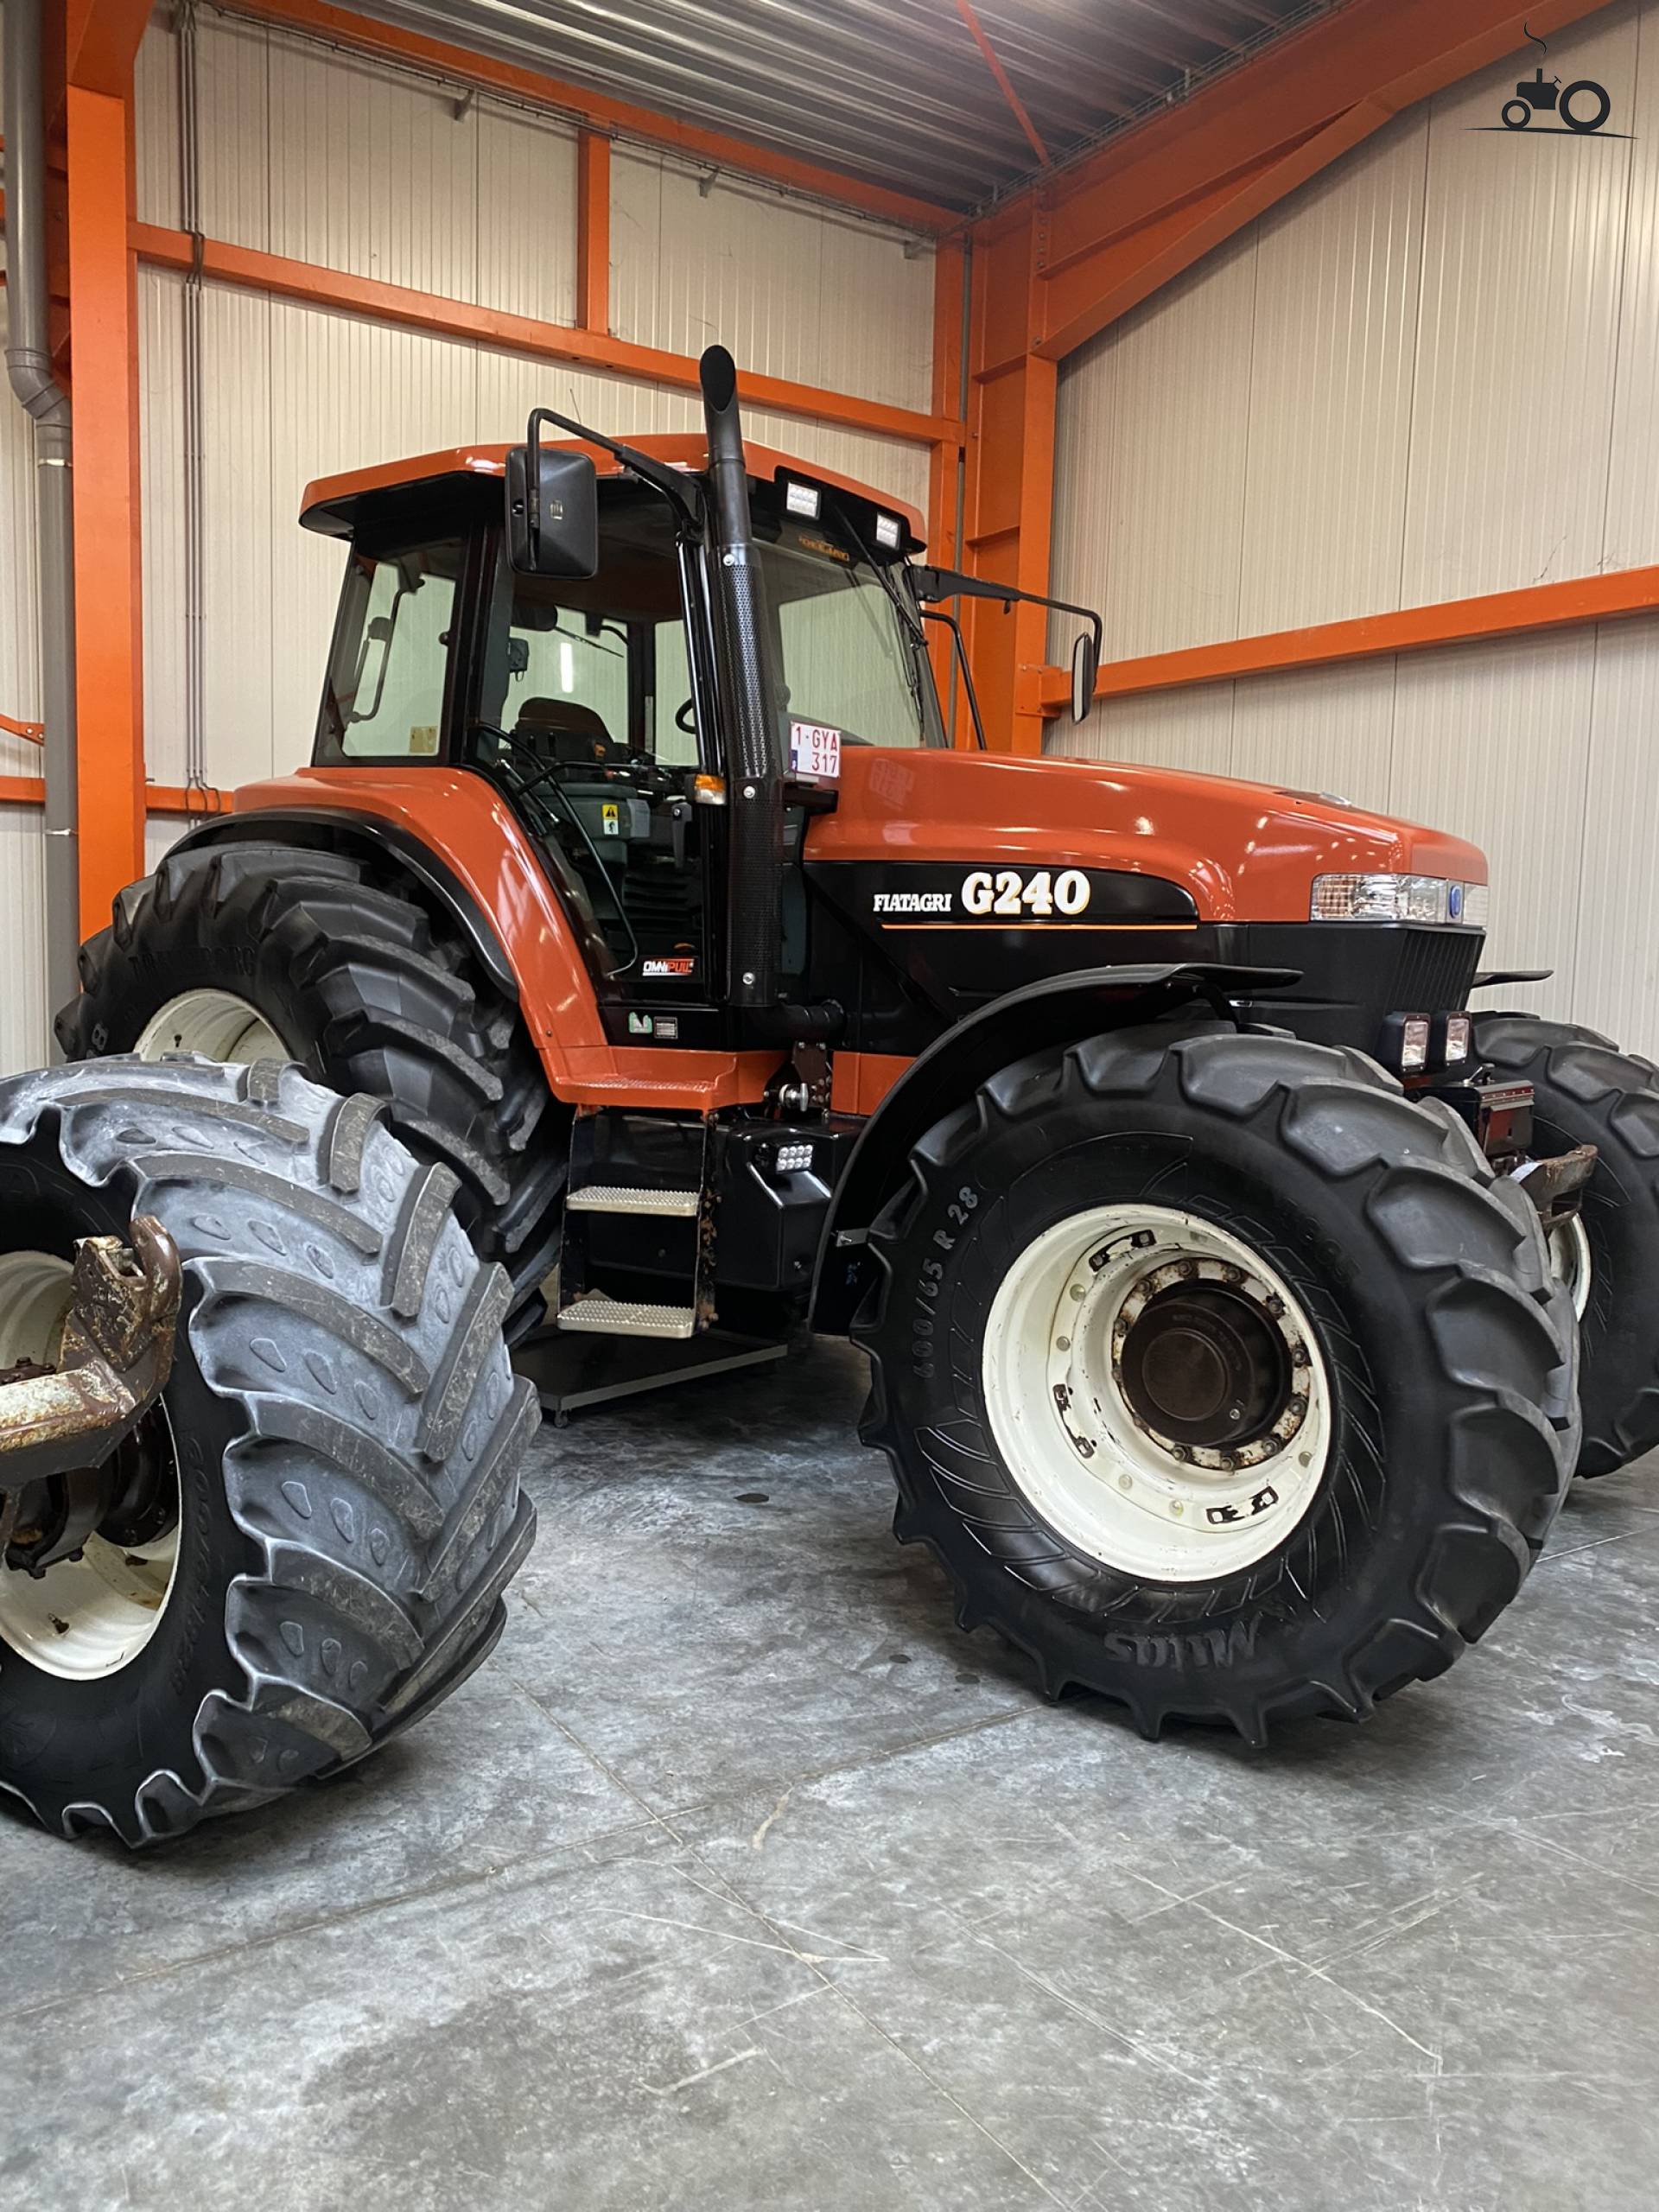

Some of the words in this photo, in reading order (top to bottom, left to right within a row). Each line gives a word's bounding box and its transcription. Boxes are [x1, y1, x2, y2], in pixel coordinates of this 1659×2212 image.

[812, 752, 836, 773] 317
[874, 893, 952, 912] FIATAGRI
[961, 870, 1091, 915] G240
[912, 1257, 944, 1378] 600/65
[932, 1228, 956, 1250] R
[947, 1185, 978, 1225] 28
